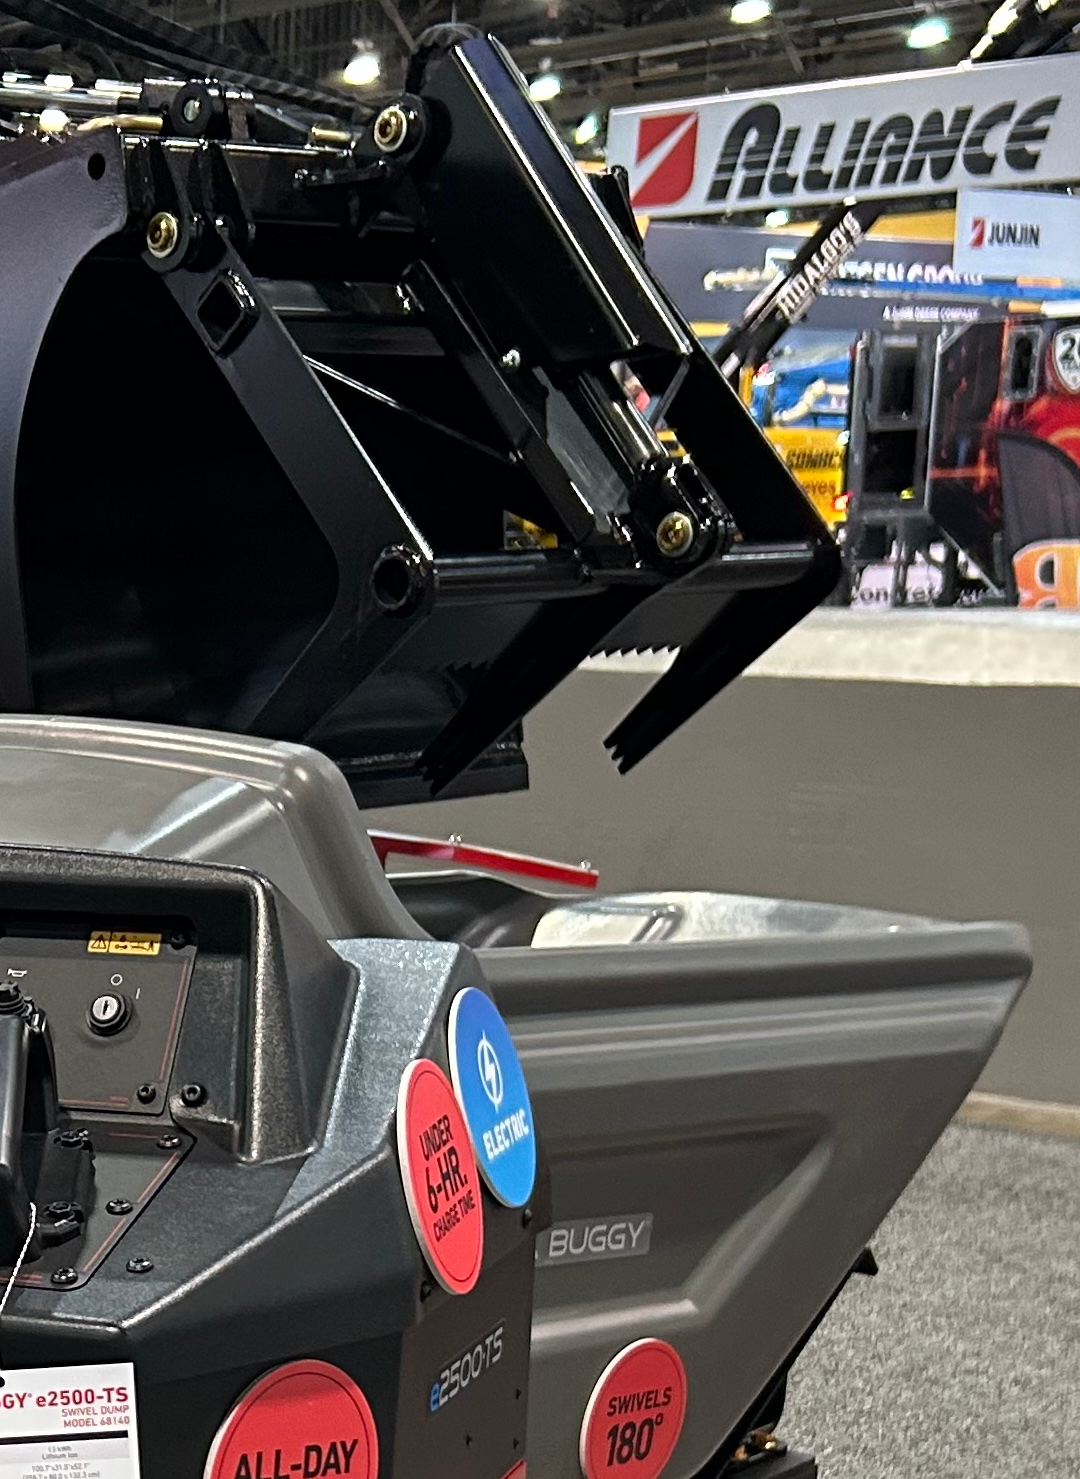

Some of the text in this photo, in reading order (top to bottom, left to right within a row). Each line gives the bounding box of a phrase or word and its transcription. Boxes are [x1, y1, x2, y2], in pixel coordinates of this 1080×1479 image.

[705, 95, 1062, 202] ALLIANCE
[988, 222, 1040, 248] JUNJIN
[419, 1115, 453, 1161] UNDER
[482, 1108, 529, 1162] ELECTRIC
[426, 1146, 468, 1214] 6-HR.
[433, 1189, 476, 1242] CHARGE TIME
[549, 1221, 645, 1257] BUGGY
[35, 1386, 128, 1407] e2500-TS
[61, 1405, 129, 1416] SWIVEL DUMP
[607, 1387, 672, 1417] SWIVELS
[63, 1416, 130, 1427] MODEL 68140
[606, 1412, 664, 1467] 180°
